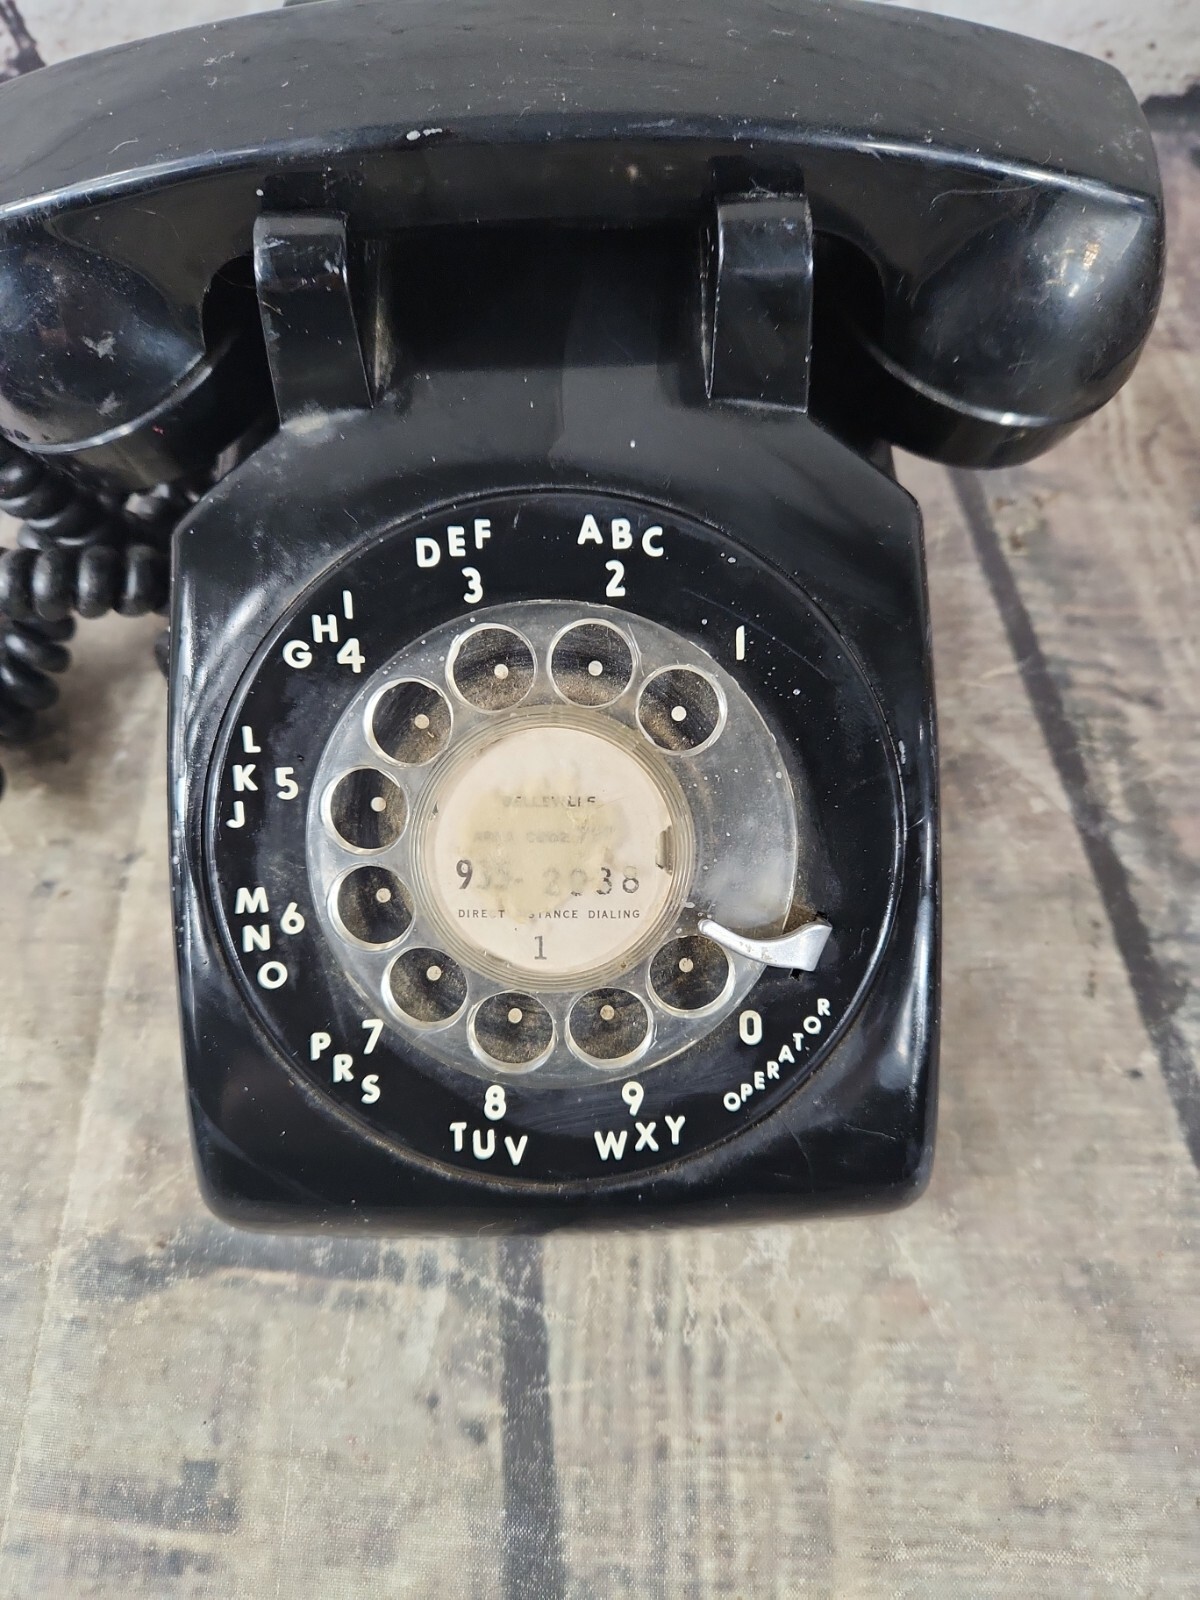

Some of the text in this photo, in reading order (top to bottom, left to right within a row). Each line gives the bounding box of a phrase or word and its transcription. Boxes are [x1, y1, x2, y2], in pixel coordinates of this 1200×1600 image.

[415, 518, 491, 569] DEF
[577, 514, 665, 558] ABC
[461, 566, 485, 605] 3
[604, 559, 627, 598] 2
[335, 636, 367, 674] 4
[275, 765, 300, 802] 5
[280, 900, 306, 936] 6
[458, 908, 505, 919] DIRET
[588, 908, 641, 919] DIALING
[533, 934, 548, 960] 1
[361, 1017, 386, 1056] 7
[722, 997, 832, 1113] OPERATOR
[310, 1032, 382, 1105] PRS
[483, 1084, 508, 1121] 8
[621, 1079, 645, 1117] 9
[449, 1120, 528, 1166] TUV
[593, 1114, 686, 1161] WXY
